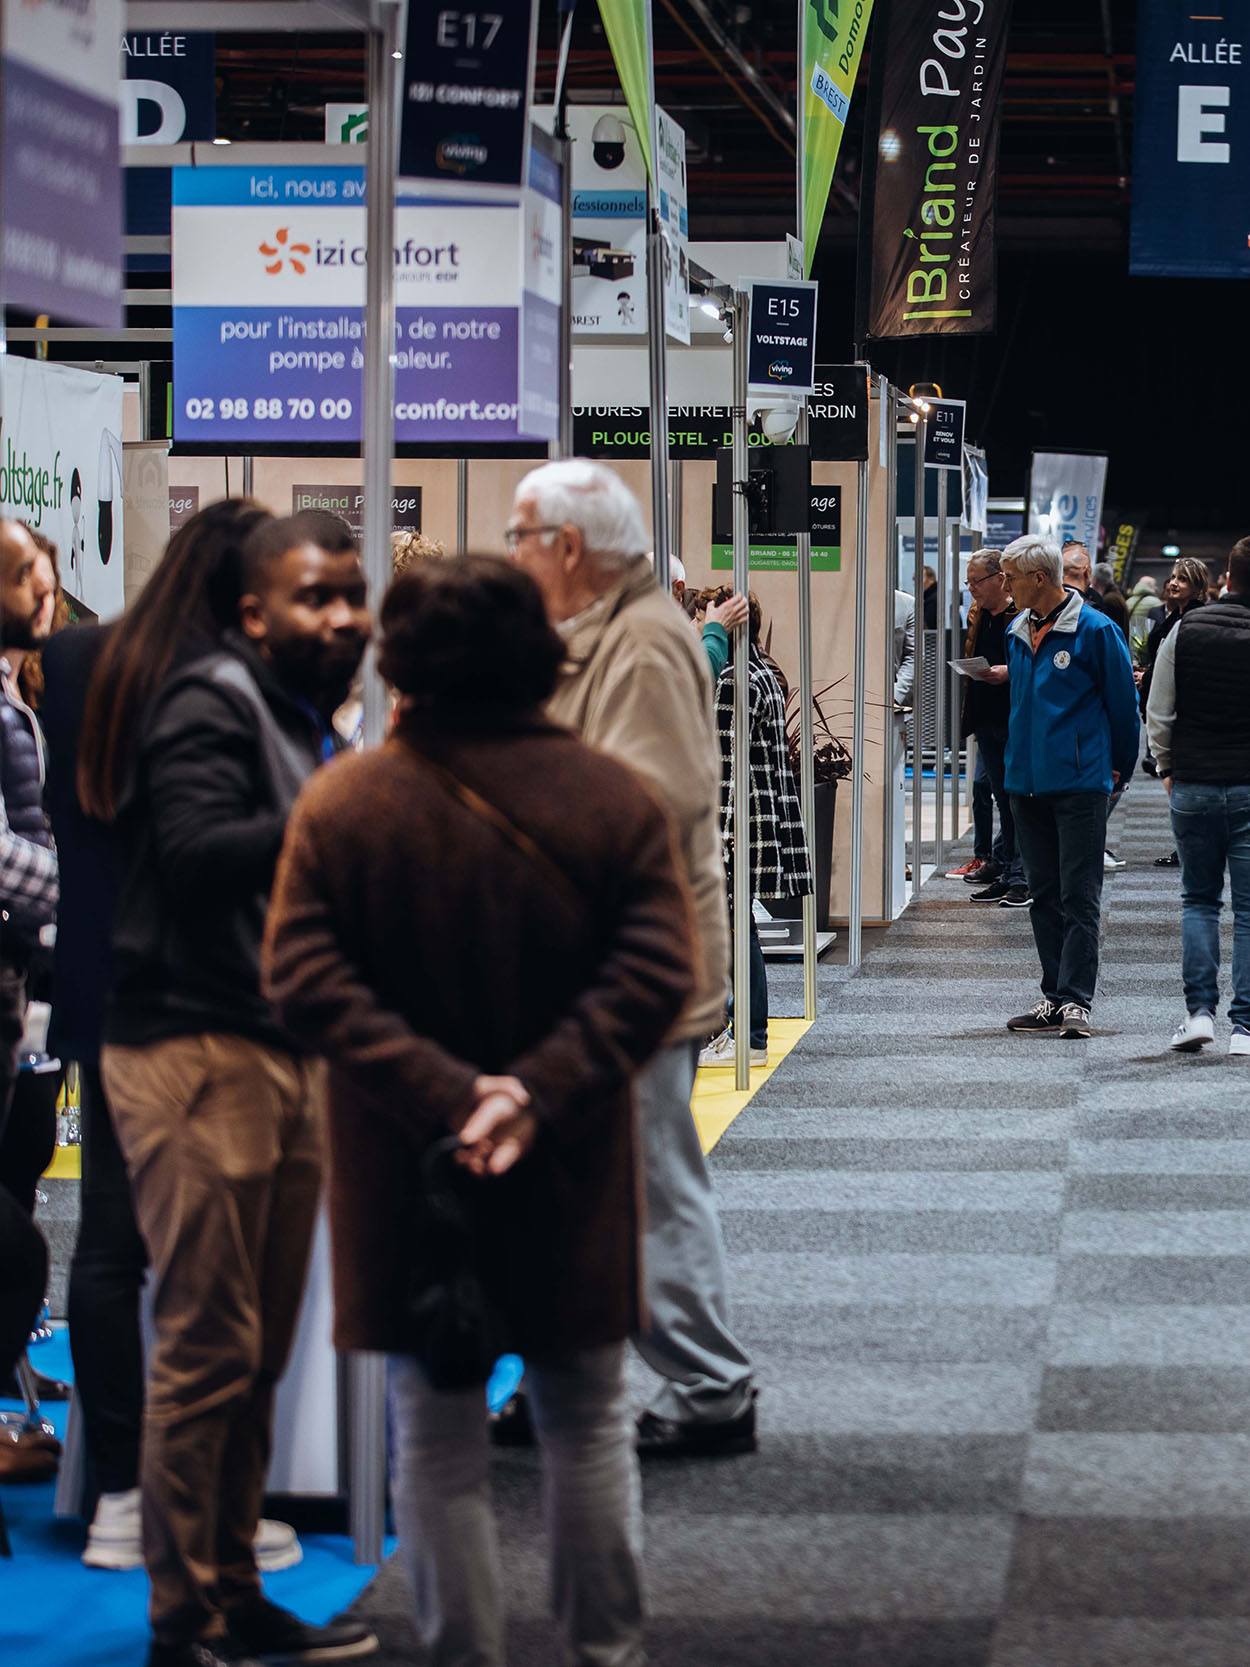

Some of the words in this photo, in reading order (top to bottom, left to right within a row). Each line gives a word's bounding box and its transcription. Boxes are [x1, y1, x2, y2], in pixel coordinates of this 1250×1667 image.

[436, 10, 503, 49] E17
[838, 0, 866, 76] Domo
[120, 31, 187, 57] ALLÉE
[1169, 38, 1243, 65] ALLÉE
[970, 37, 987, 122] JARDIN
[815, 73, 846, 114] BREST
[120, 79, 187, 145] D
[1176, 84, 1231, 164] E
[968, 137, 981, 164] DE
[250, 175, 279, 198] Ici,
[285, 179, 337, 198] nous
[573, 195, 645, 214] fessionnels
[903, 125, 960, 303] Briand
[315, 239, 345, 266] izi
[350, 239, 459, 266] cfort
[958, 180, 977, 300] CRÉATEUR
[768, 297, 801, 318] E15
[221, 321, 272, 344] pour
[278, 315, 402, 339] l'installatn
[408, 316, 437, 340] de
[442, 319, 501, 340] notre
[756, 334, 809, 348] VOLTSTAGE
[269, 350, 345, 374] pompe
[351, 346, 364, 369] à
[396, 346, 453, 370] aleur.
[771, 364, 794, 376] viving
[186, 398, 215, 420] 02
[219, 398, 249, 420] 98
[253, 398, 283, 420] 88
[287, 398, 316, 420] 70
[320, 398, 353, 420] 00
[807, 404, 857, 419] ARDIN
[936, 410, 955, 423] E11
[592, 431, 708, 446] PLOUGSTEL
[935, 430, 954, 438] RENOV
[0, 437, 64, 529] oltstage.fr
[302, 493, 349, 509] Briand
[750, 549, 777, 557] BRIAND
